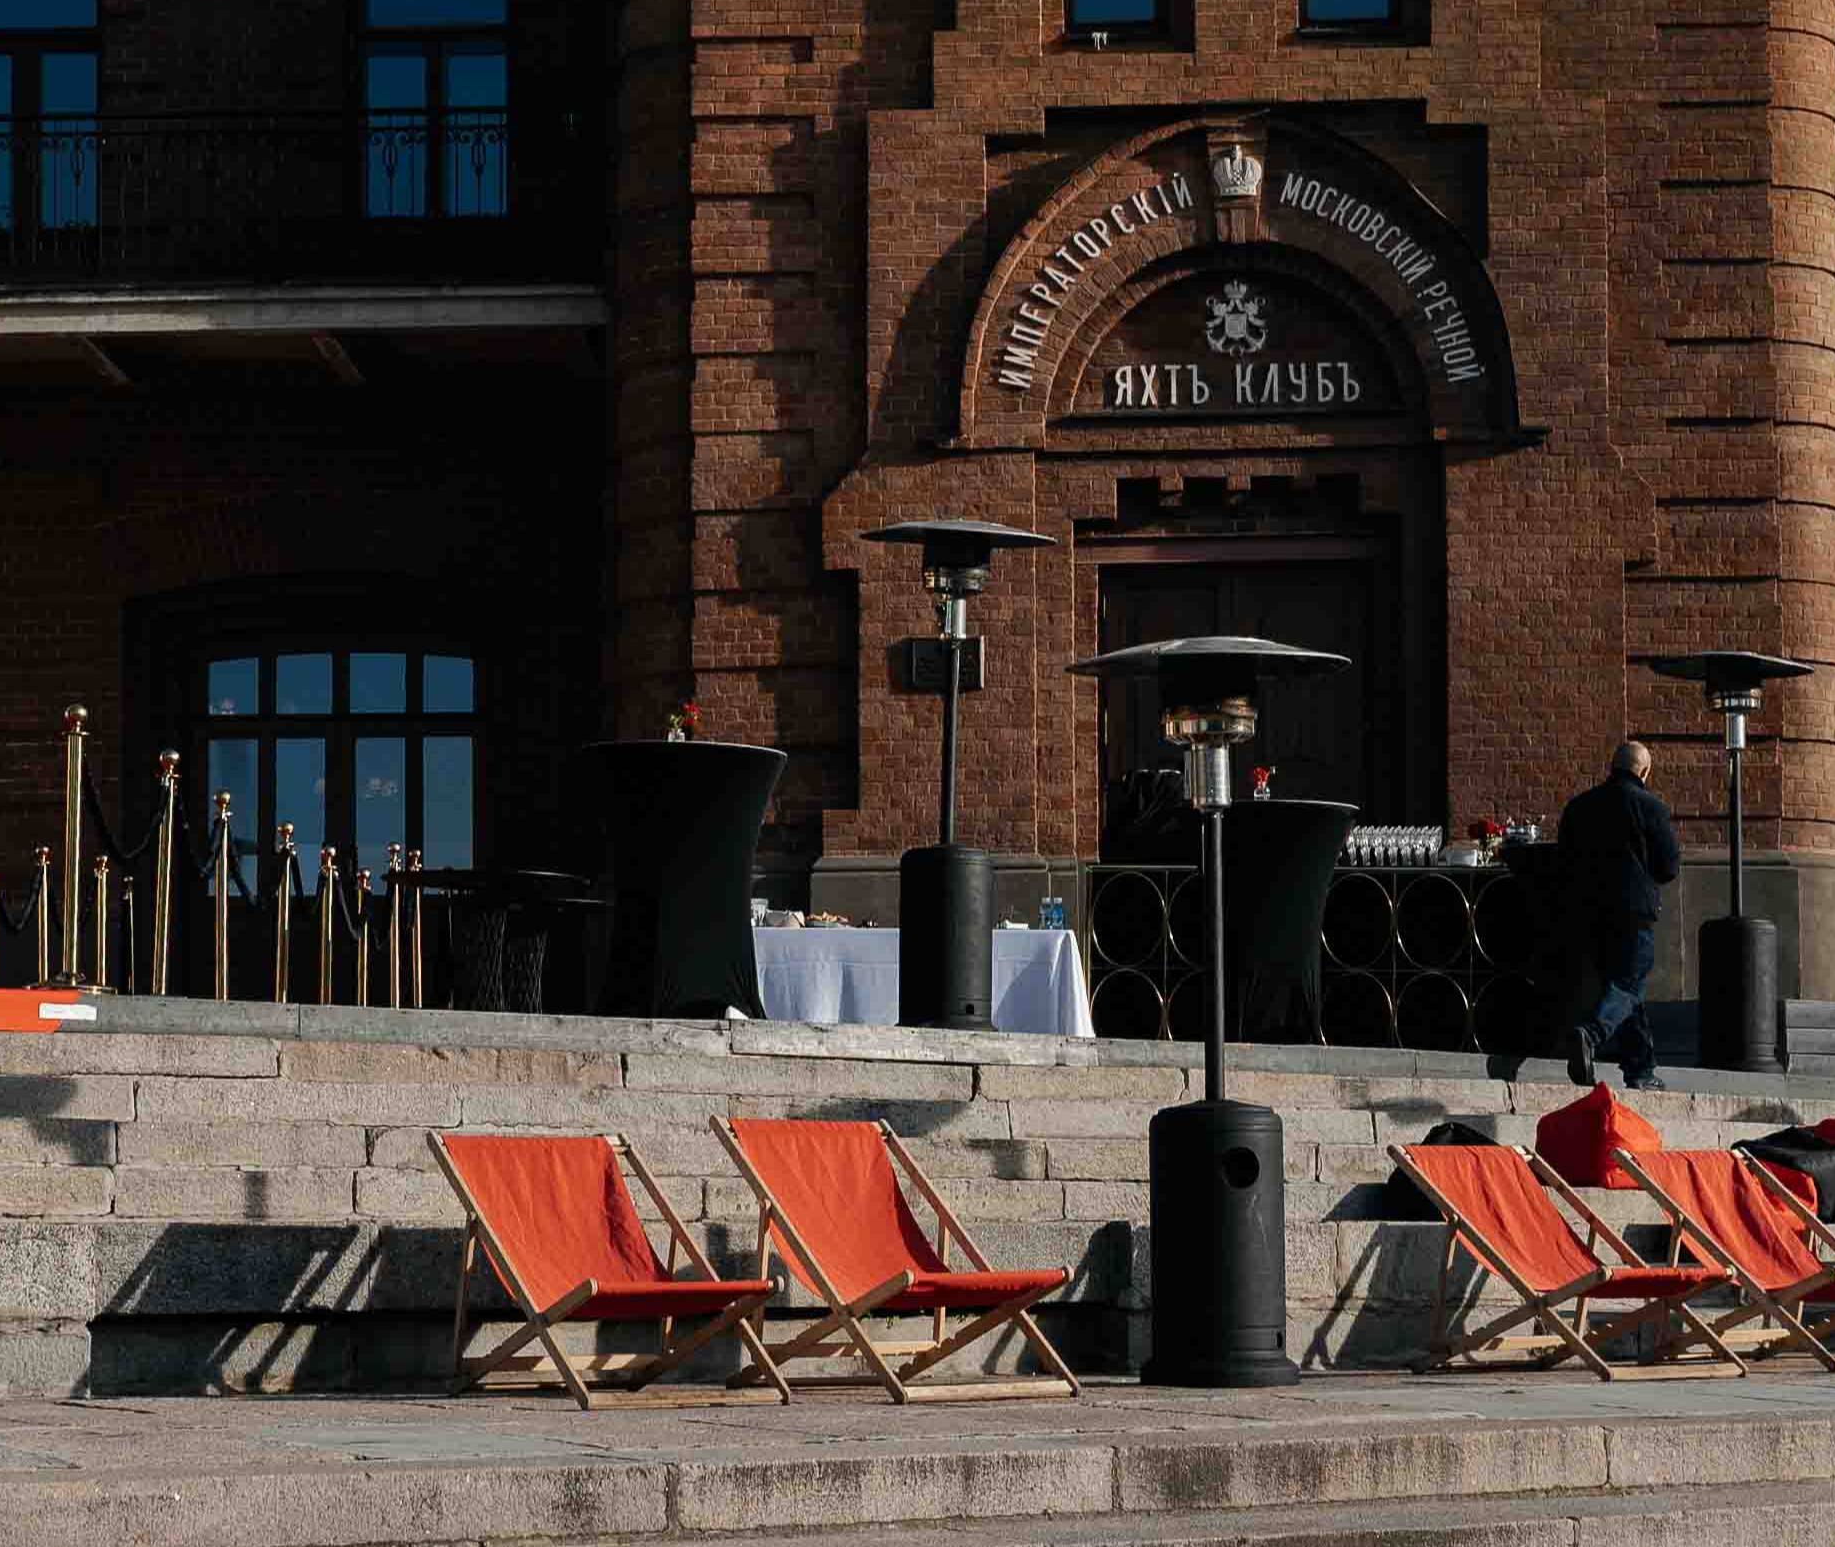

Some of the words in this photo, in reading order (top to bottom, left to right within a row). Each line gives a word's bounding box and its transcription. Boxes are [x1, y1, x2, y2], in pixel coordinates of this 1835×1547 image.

[998, 172, 1194, 389] ИМПЕРАТОРСКІЙ
[1416, 280, 1486, 383] РЕЧНОЙ
[1114, 363, 1210, 406] ЯХТЪ
[1235, 362, 1361, 403] КЛУБЪ
